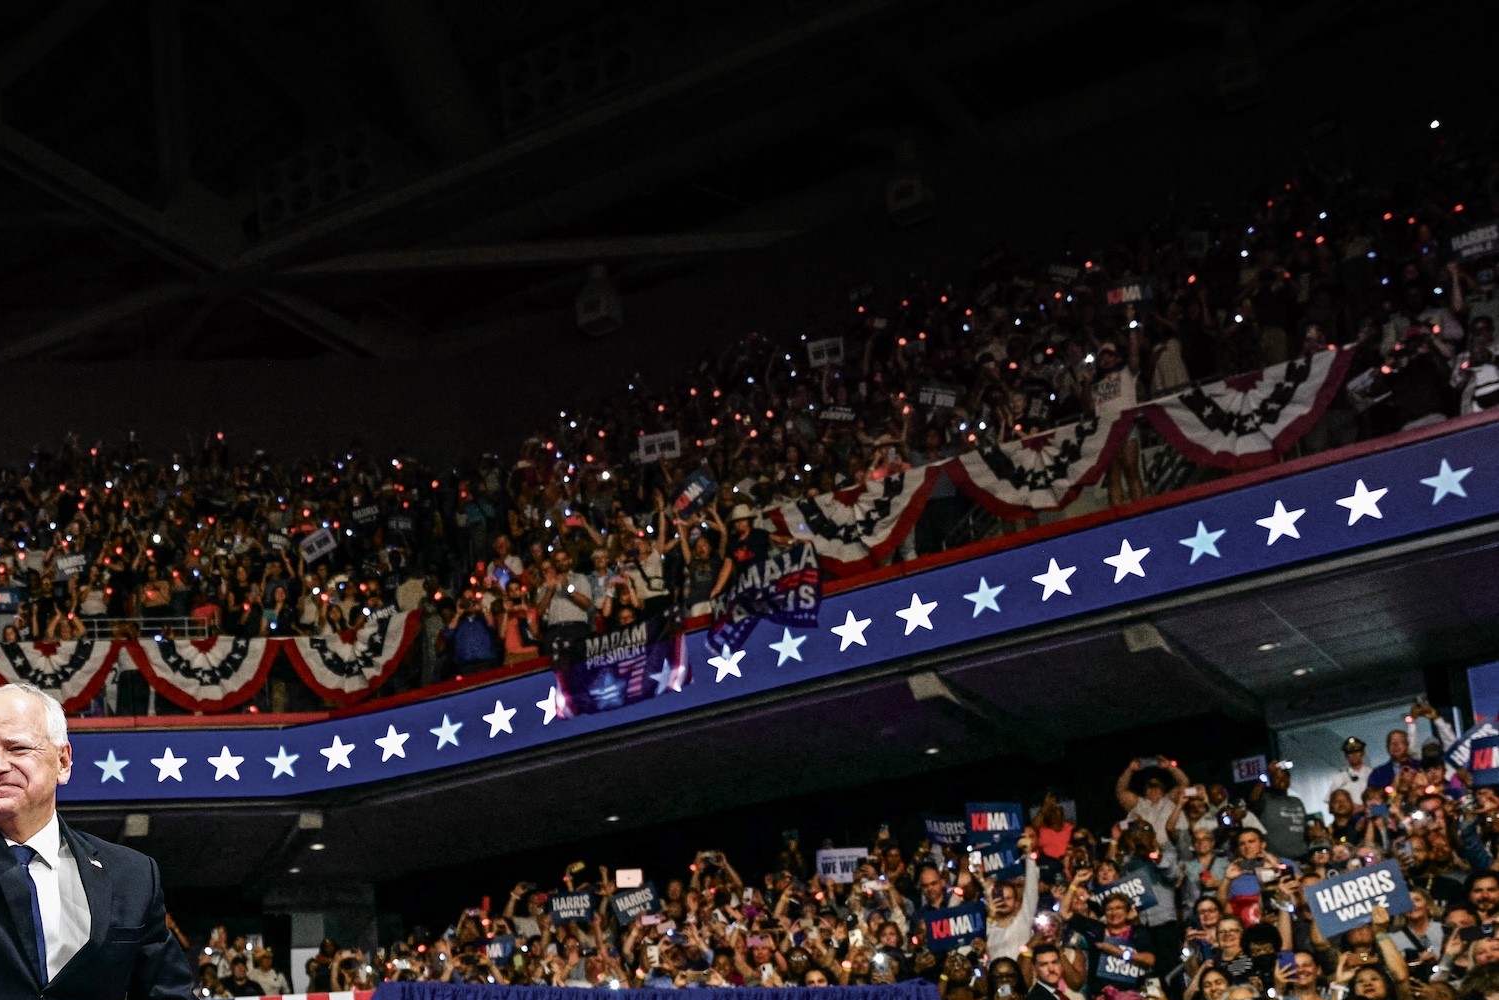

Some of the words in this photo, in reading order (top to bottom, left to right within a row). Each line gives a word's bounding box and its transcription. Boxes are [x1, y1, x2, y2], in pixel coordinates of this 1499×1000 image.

[585, 623, 648, 657] MADAM
[585, 645, 647, 670] PRESIDENT
[925, 819, 967, 836] HARRIS
[971, 812, 1020, 831] KAMALA
[821, 860, 837, 876] WE
[982, 850, 1015, 872] MALA
[552, 894, 590, 911] HARRIS
[615, 887, 654, 912] HARRIS
[1315, 870, 1396, 914] HARRIS
[559, 908, 586, 919] WALZ
[1336, 894, 1391, 923] WALZ
[931, 912, 985, 940] KAMALA
